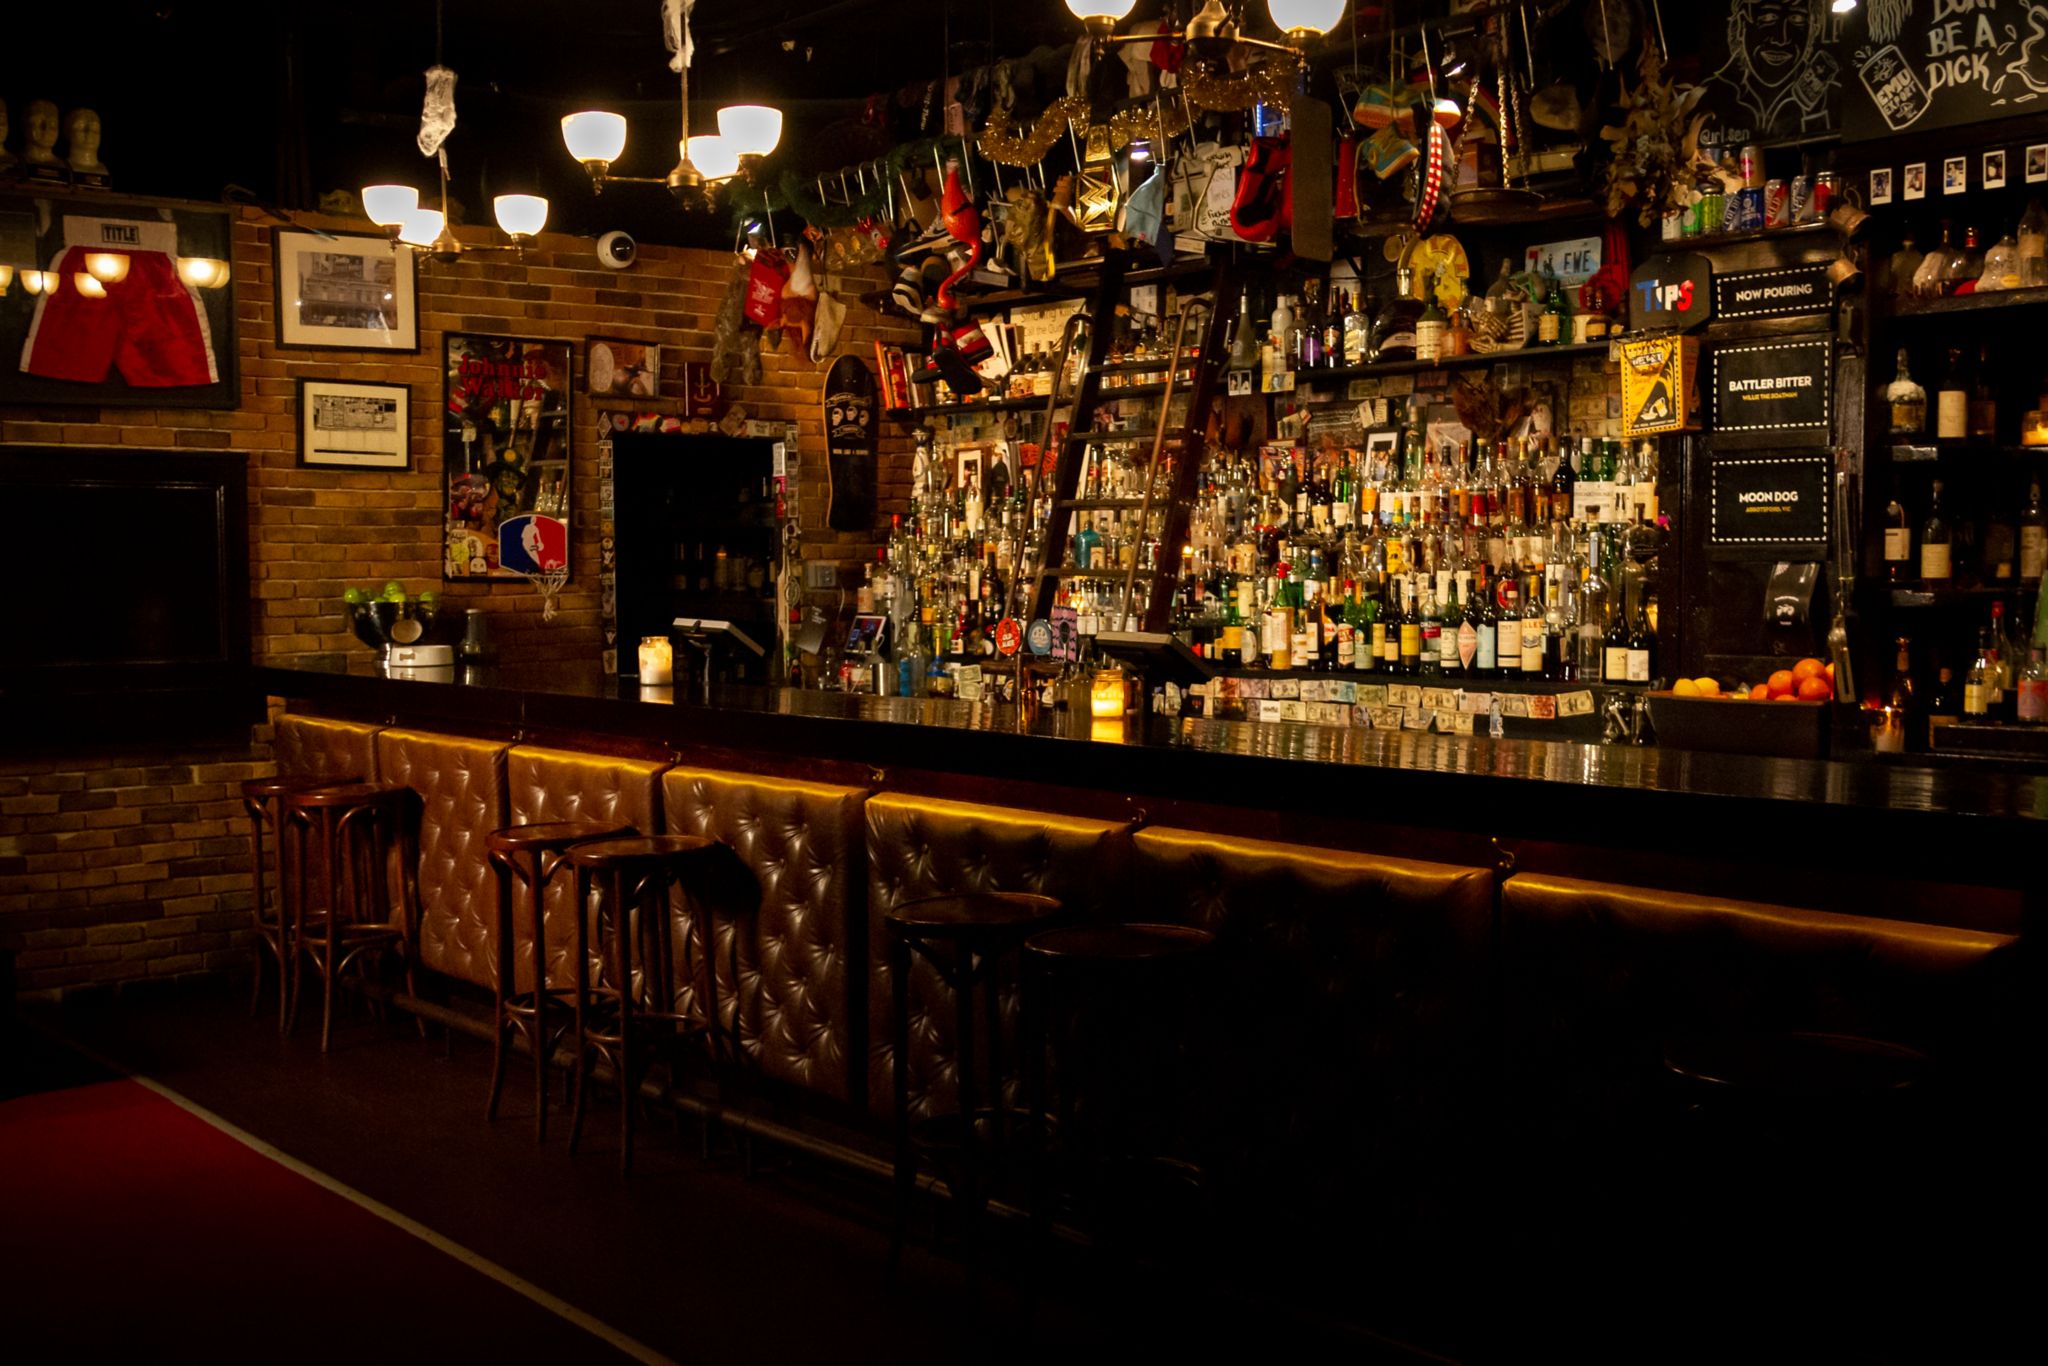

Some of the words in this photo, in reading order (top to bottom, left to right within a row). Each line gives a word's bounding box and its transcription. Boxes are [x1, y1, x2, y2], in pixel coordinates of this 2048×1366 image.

[1926, 21, 1968, 58] BE
[1974, 13, 1998, 49] A
[1876, 68, 1914, 103] EMU
[1925, 51, 1989, 100] DICK
[1882, 80, 1918, 116] EXPORT
[104, 226, 136, 241] TITLE
[1736, 288, 1762, 302] NOW
[1764, 283, 1813, 299] POURING
[459, 354, 546, 379] Johnnie
[461, 375, 545, 401] Walker
[1728, 379, 1774, 392] BATTLER
[1775, 375, 1813, 389] BITTER
[1738, 491, 1773, 503] MOON
[1774, 490, 1799, 502] DOG
